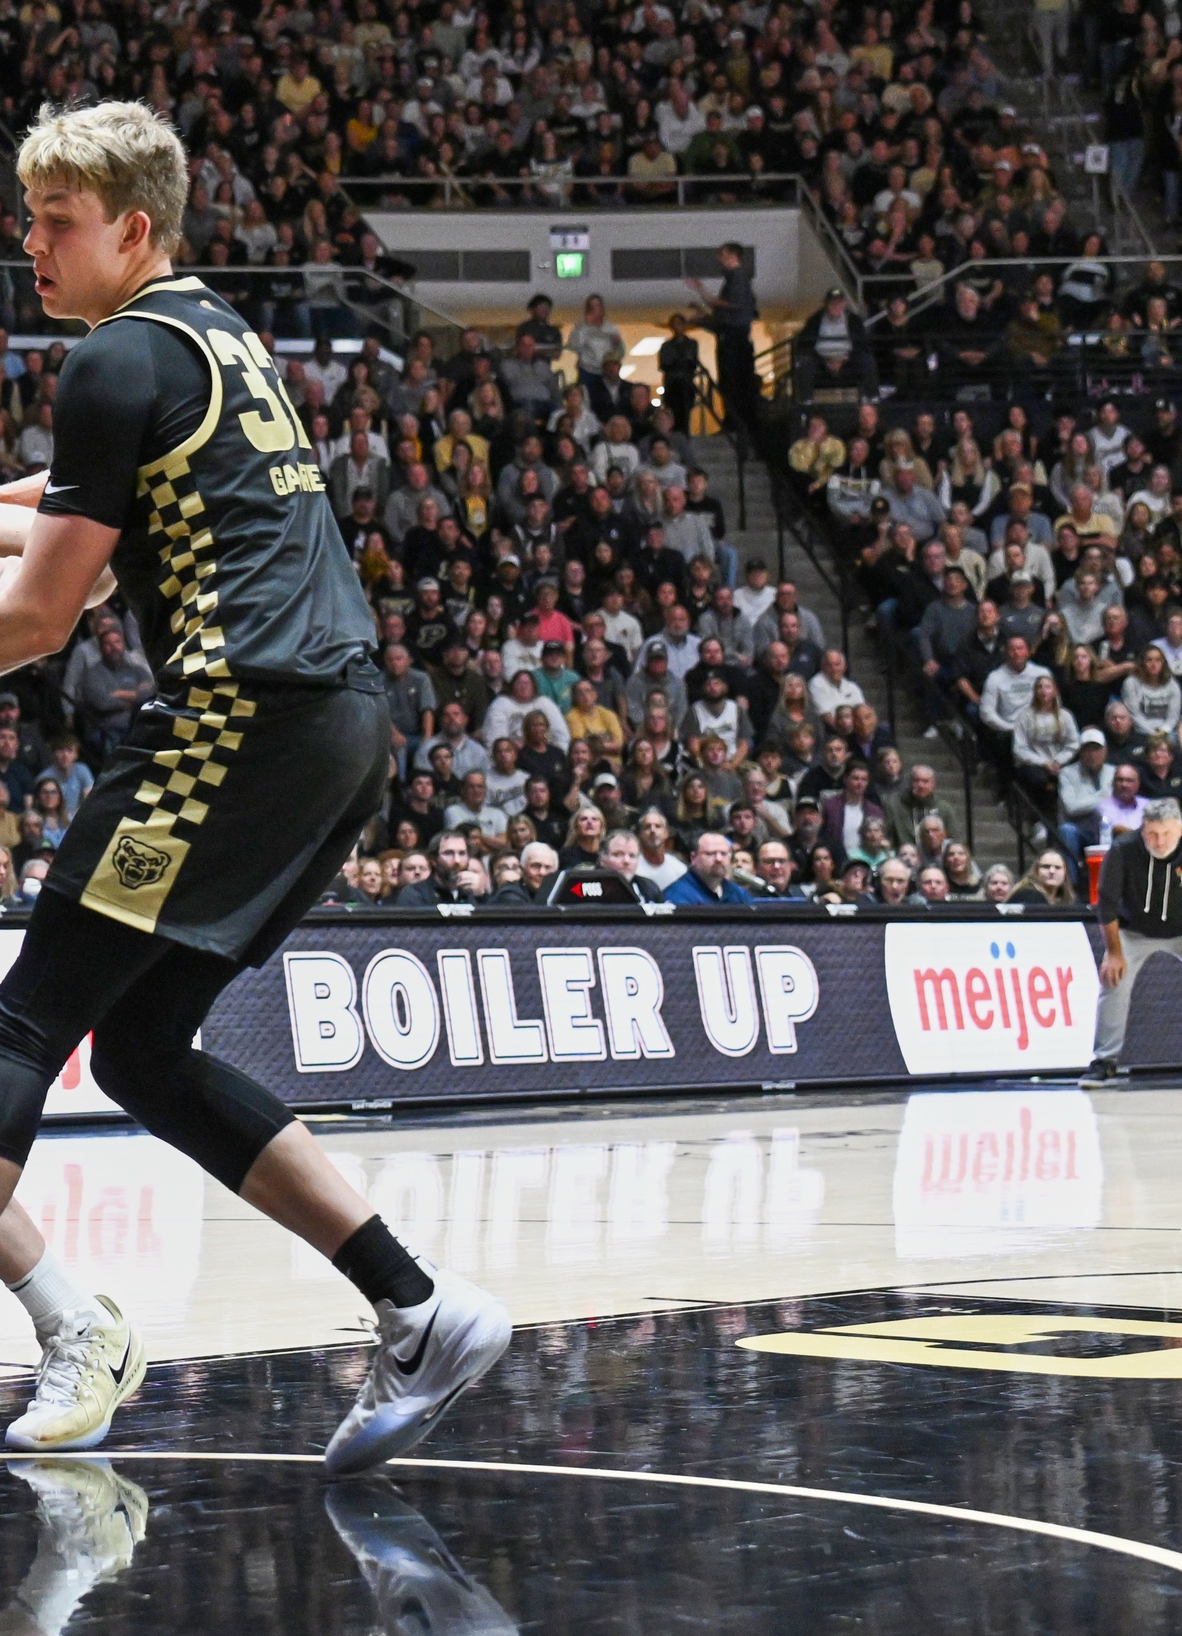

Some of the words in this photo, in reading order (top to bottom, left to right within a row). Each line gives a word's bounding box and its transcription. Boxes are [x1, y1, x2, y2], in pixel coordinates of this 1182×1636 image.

[283, 947, 676, 1073] BOILER
[692, 945, 820, 1057] UP
[914, 941, 1073, 1051] meijer
